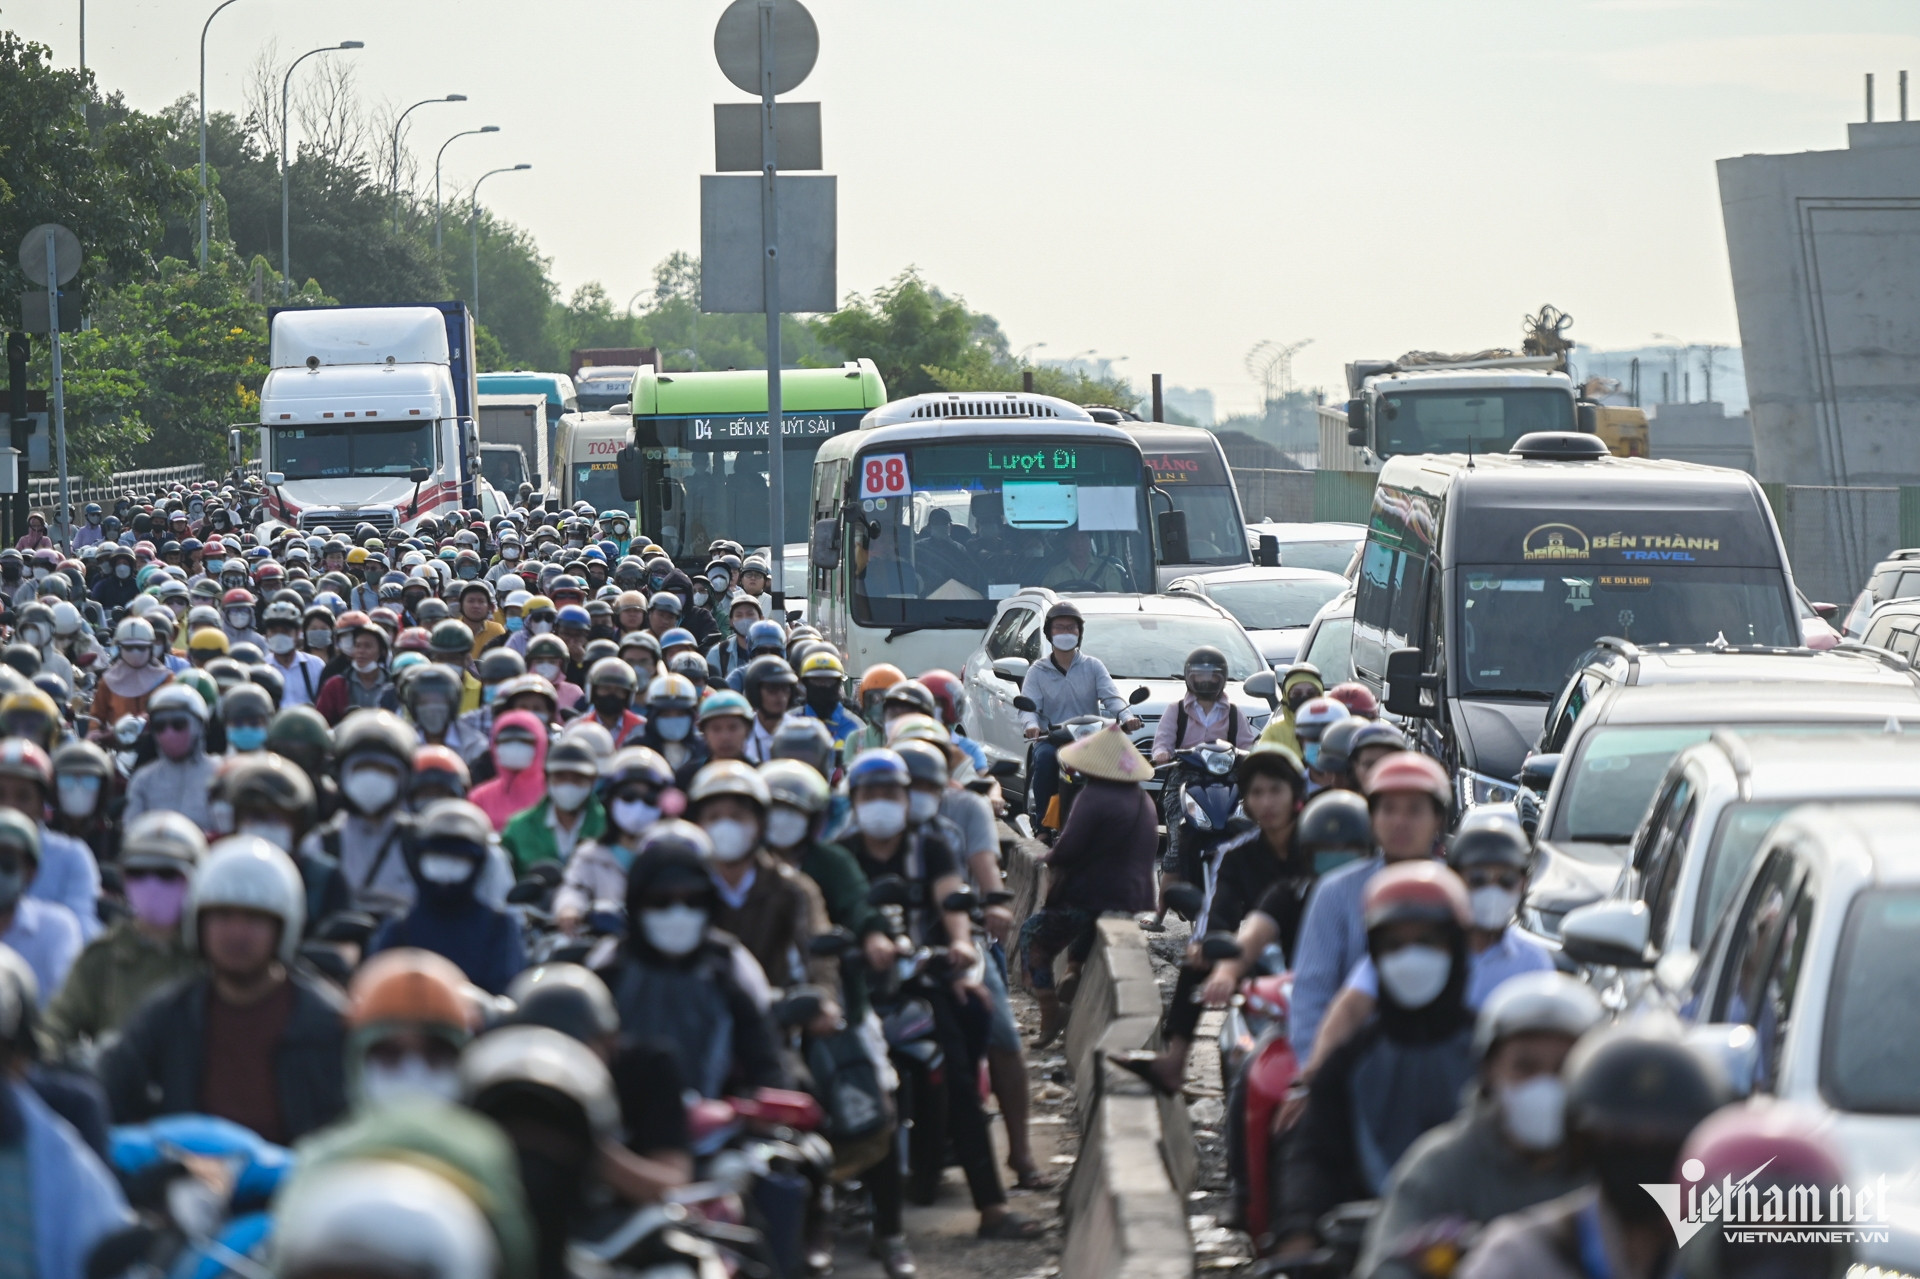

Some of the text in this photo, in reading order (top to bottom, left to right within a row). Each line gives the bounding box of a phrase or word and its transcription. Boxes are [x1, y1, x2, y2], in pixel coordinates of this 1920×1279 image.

[694, 419, 713, 439] D4
[729, 417, 753, 436] BẾN
[780, 417, 804, 435] UÝT
[988, 450, 1046, 473] Lượt
[866, 458, 905, 493] 88
[1592, 531, 1720, 551] BẾN THÀNH
[1622, 551, 1696, 561] TRAVEL
